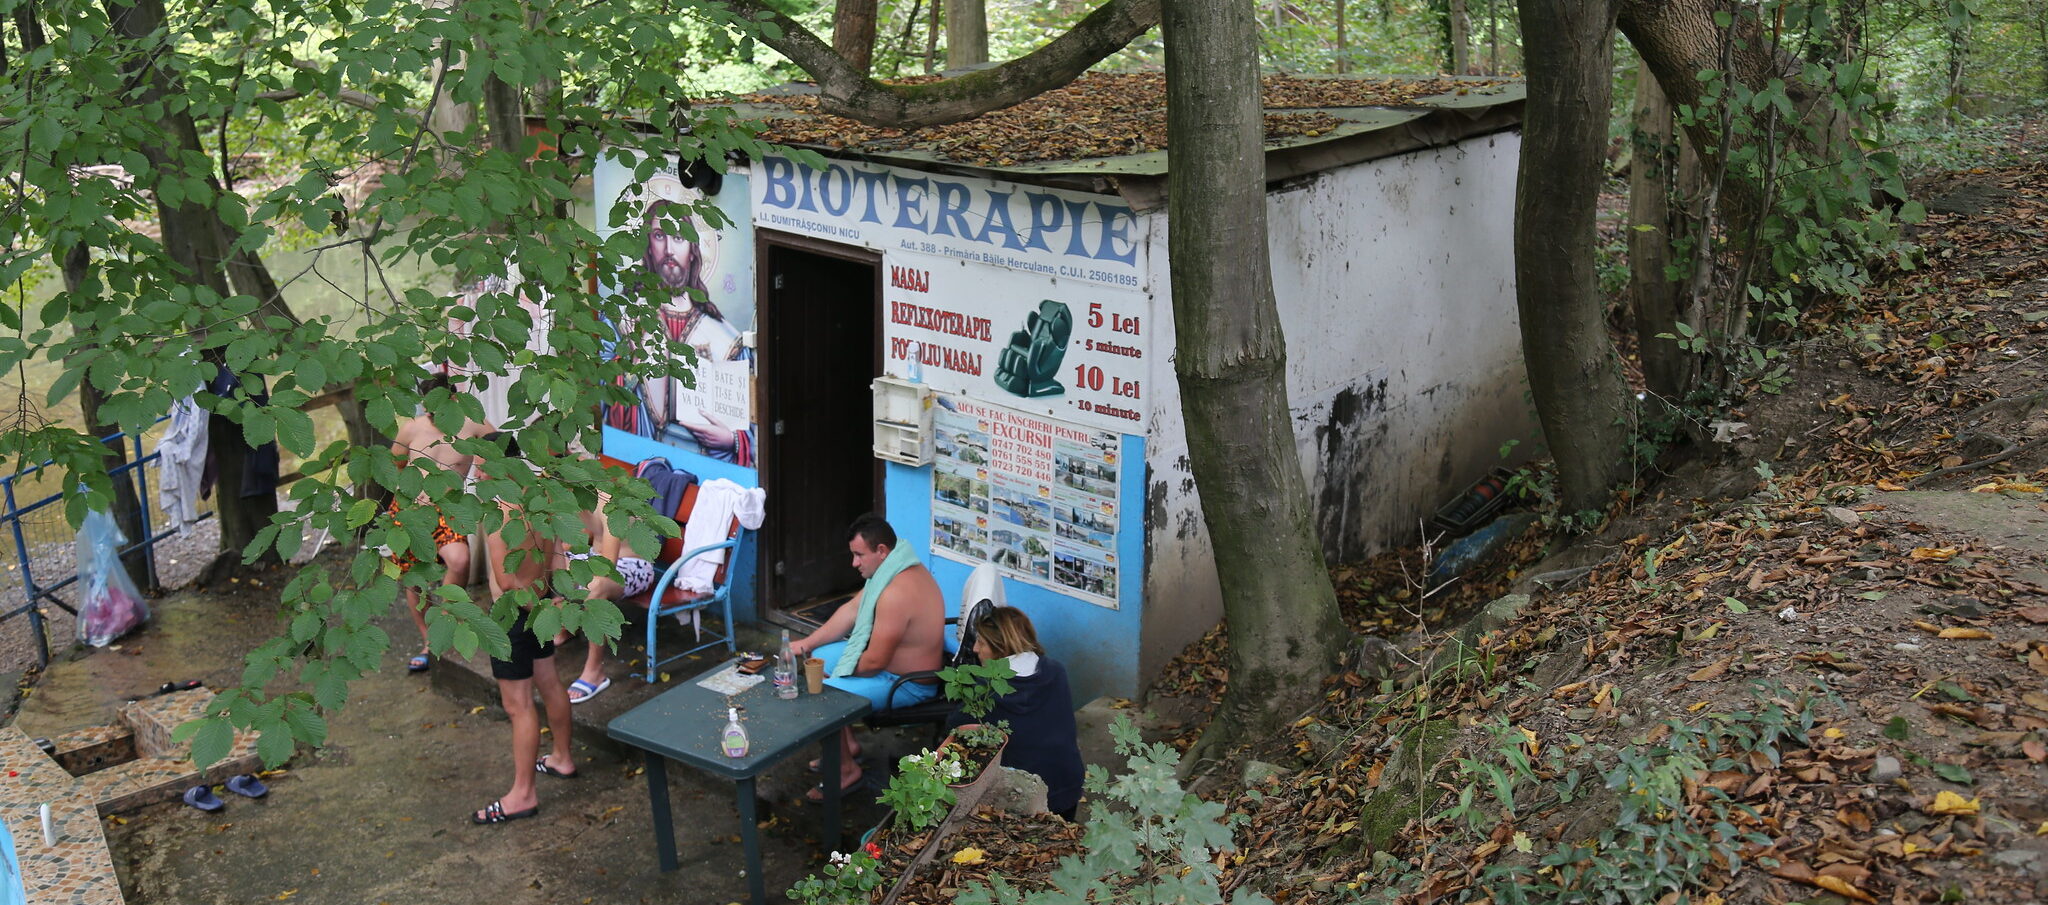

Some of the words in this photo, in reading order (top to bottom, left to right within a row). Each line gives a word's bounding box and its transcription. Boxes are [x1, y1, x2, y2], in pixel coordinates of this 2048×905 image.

[762, 156, 1138, 267] BIOTERAPIE
[839, 227, 860, 239] NICU
[891, 265, 930, 293] MASAJ
[901, 240, 918, 251] Aut.
[920, 242, 936, 253] 388
[1007, 257, 1057, 275] Herculane,
[1060, 265, 1086, 280] C.U.I.
[1089, 270, 1138, 287] 25061895
[891, 301, 992, 342] REFLEXOTERAPIE
[1088, 302, 1104, 329] 5
[1112, 312, 1140, 336] Lei
[943, 347, 982, 377] MASAJ
[1085, 339, 1094, 351] 5
[1096, 341, 1142, 359] minute
[1075, 364, 1105, 392] 10
[1112, 376, 1141, 400] Lei
[976, 406, 986, 417] SE
[990, 409, 1005, 421] FAC
[1055, 426, 1091, 443] PENTRU
[1094, 403, 1141, 421] minute
[993, 422, 1052, 449] EXCURSII
